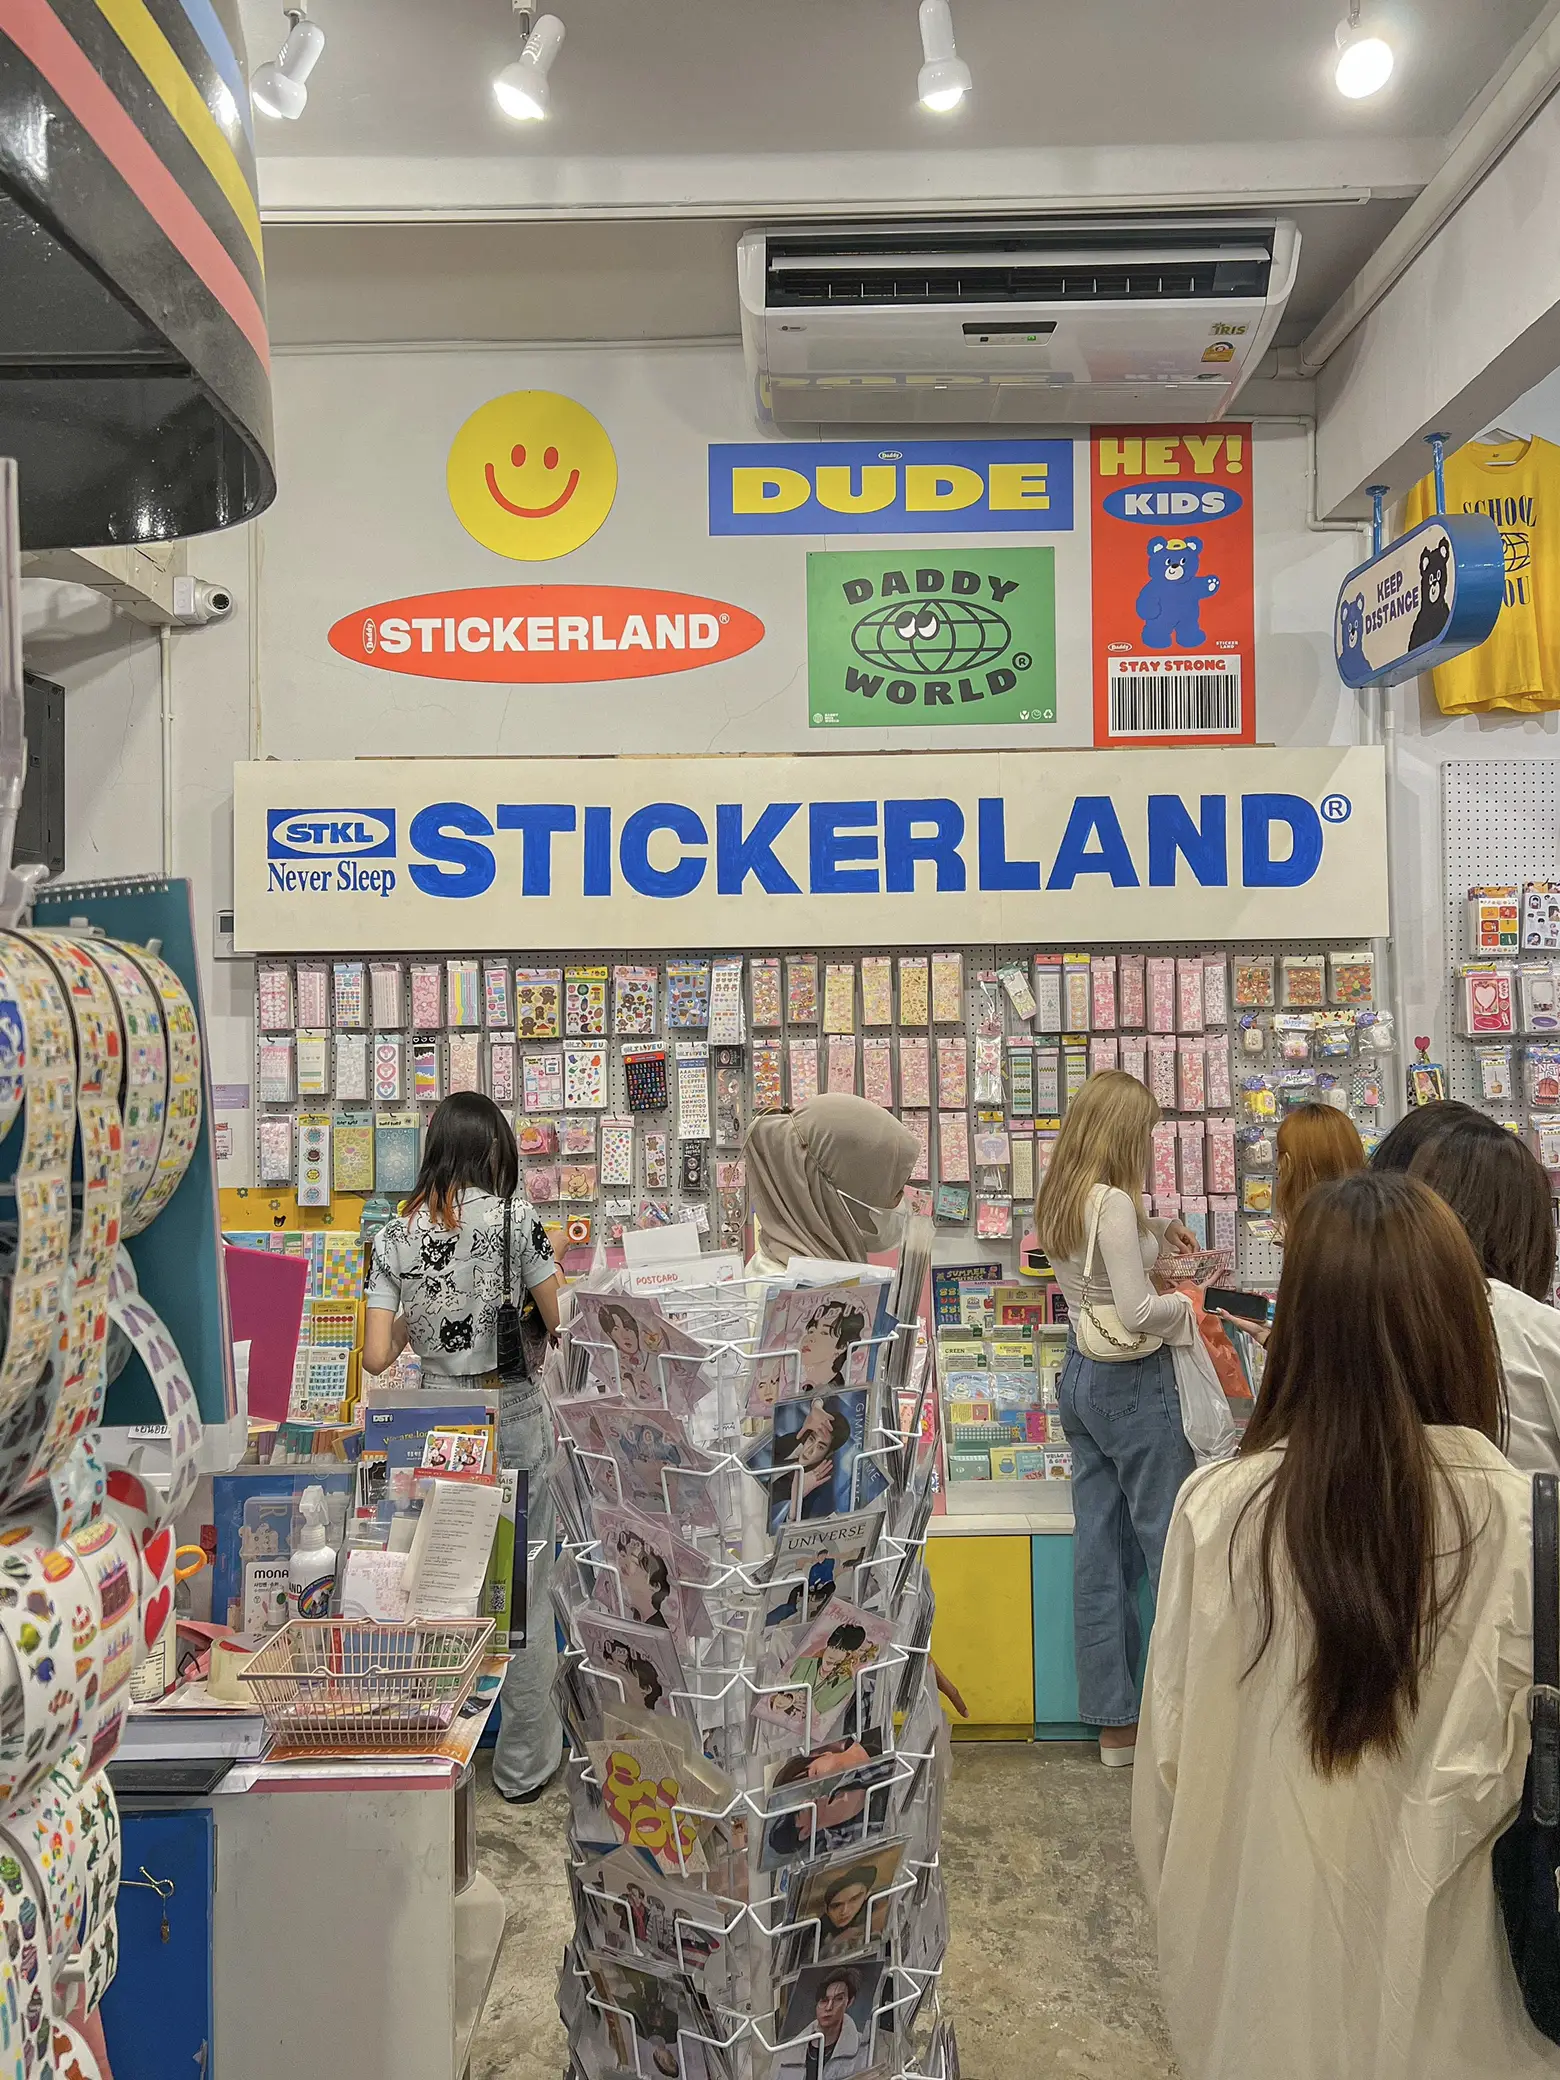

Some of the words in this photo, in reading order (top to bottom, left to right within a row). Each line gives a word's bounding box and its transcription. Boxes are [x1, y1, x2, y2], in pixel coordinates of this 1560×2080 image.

[1100, 435, 1243, 475] HEY!
[732, 463, 1050, 514] DUDE
[1124, 491, 1226, 515] KIDS
[842, 569, 1019, 605] DADDY
[1377, 570, 1404, 603] KEEP
[1365, 584, 1419, 635] DISTANCE
[1119, 661, 1161, 673] STAY
[1164, 659, 1226, 671] STRONG
[286, 822, 374, 844] STKL
[266, 861, 333, 892] Never
[336, 860, 397, 897] Sleep
[635, 1273, 679, 1286] POSTCARD
[854, 1402, 865, 1449] GIMME
[788, 1523, 867, 1550] UNIVERSE
